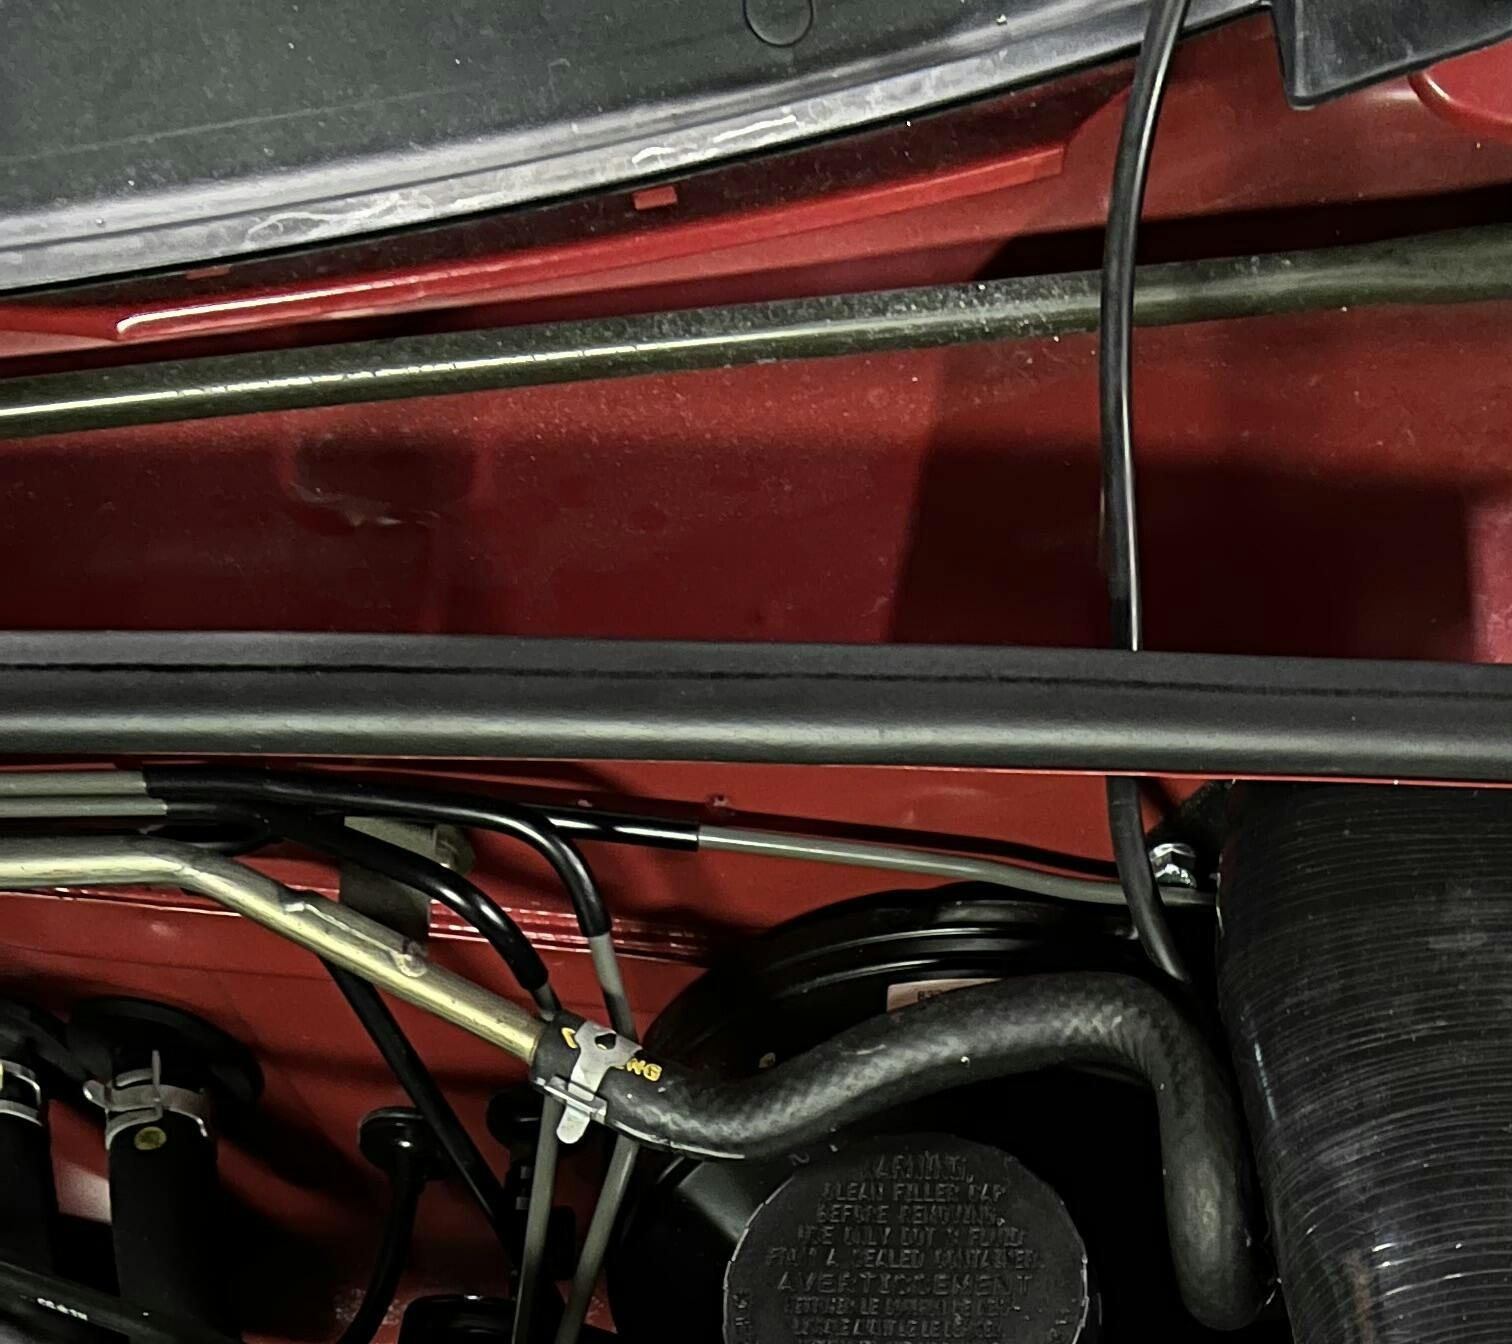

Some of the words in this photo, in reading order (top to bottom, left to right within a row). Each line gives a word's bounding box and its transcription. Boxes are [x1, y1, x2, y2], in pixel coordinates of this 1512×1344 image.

[823, 1182, 884, 1202] CLEAN
[893, 1182, 959, 1202] FILLER
[969, 1183, 1006, 1202] CAP
[816, 1204, 890, 1224] BEFORE
[825, 1247, 837, 1267] A
[853, 1248, 925, 1269] SEALED
[777, 1271, 1034, 1297] AVERTISSEMENT
